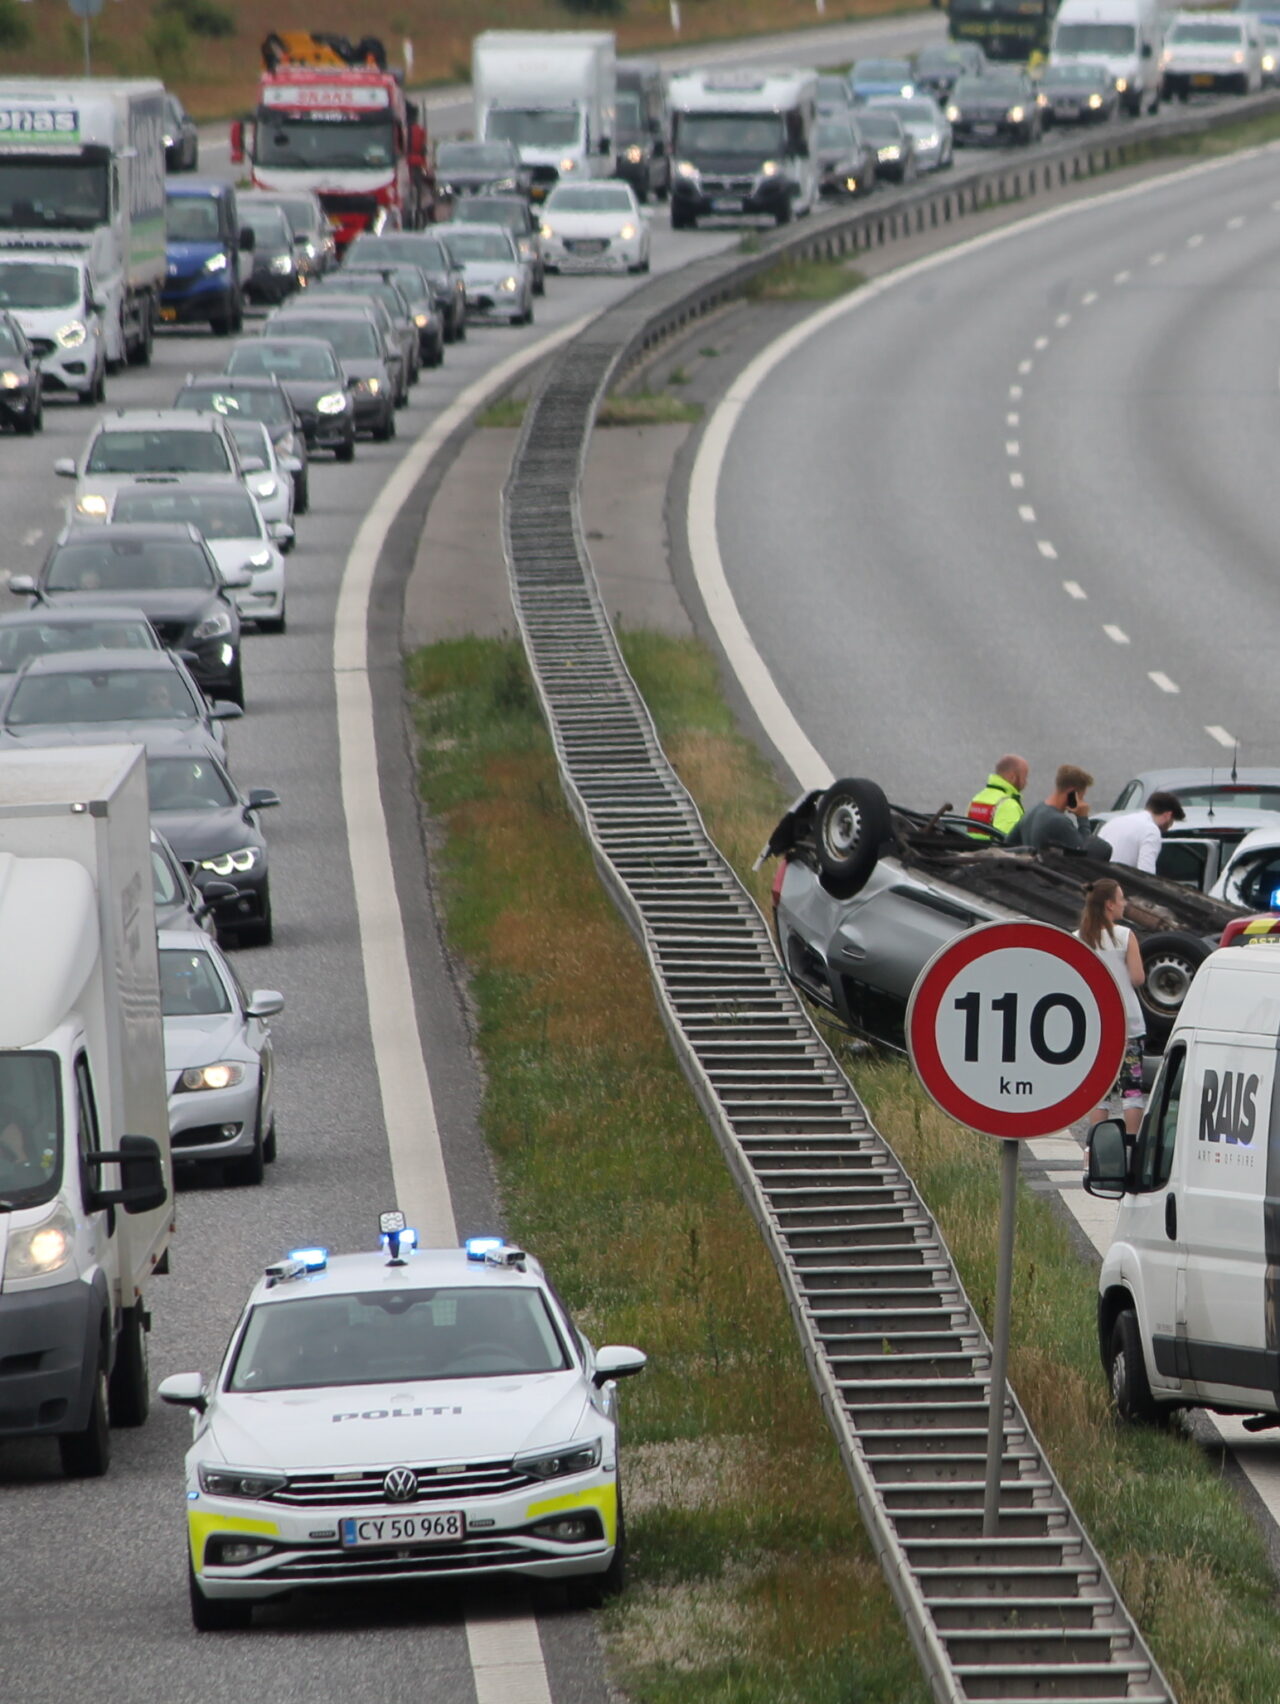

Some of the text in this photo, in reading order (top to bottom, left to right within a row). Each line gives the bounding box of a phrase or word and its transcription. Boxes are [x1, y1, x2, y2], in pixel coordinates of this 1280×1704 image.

[954, 991, 1087, 1065] 110
[1000, 1076, 1033, 1095] km
[1199, 1069, 1260, 1146] RAIS
[332, 1405, 463, 1423] POLITI
[358, 1515, 459, 1540] CY 50 968
